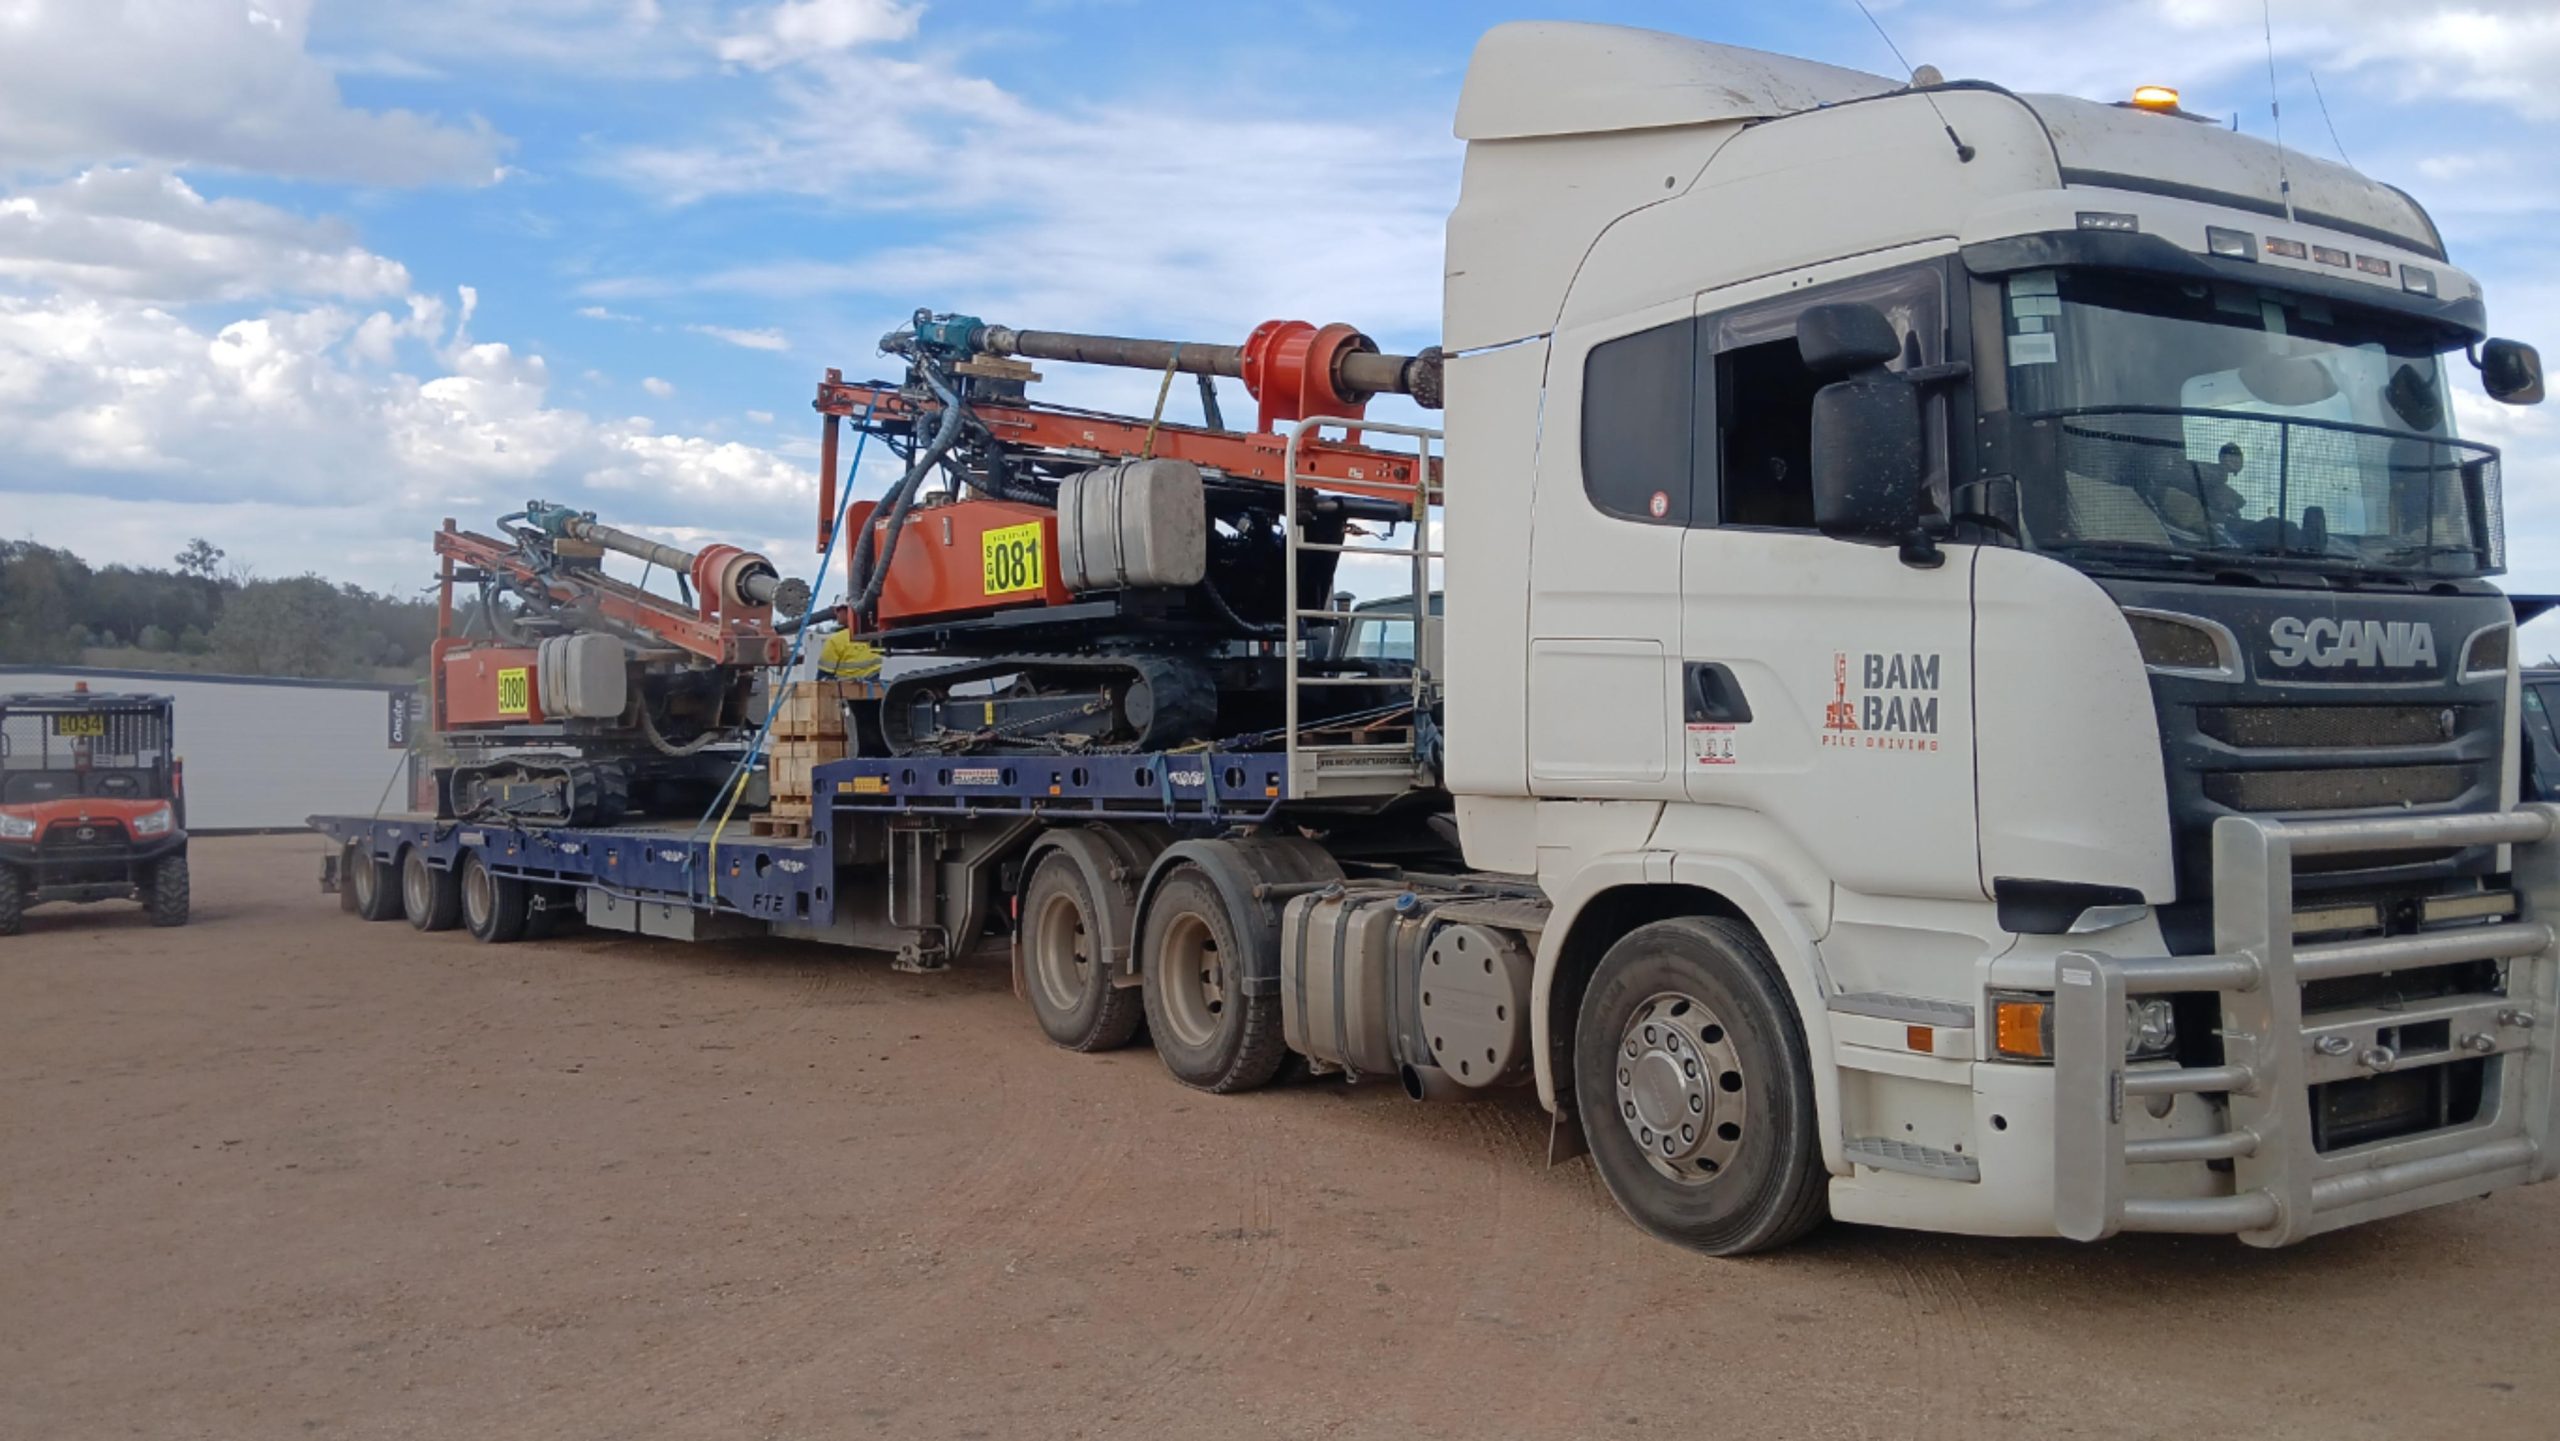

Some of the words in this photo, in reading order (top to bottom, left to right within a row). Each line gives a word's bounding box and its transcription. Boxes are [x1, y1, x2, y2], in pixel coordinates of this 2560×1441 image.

[995, 537, 1038, 589] 081
[2269, 616, 2438, 668] SCANIA
[1863, 653, 1940, 690] BAM
[504, 676, 526, 708] 080
[69, 715, 102, 732] 034
[1862, 696, 1938, 734] BAM
[1822, 735, 1856, 747] PILE
[1866, 737, 1938, 751] DRIVING
[752, 894, 785, 912] FTE
